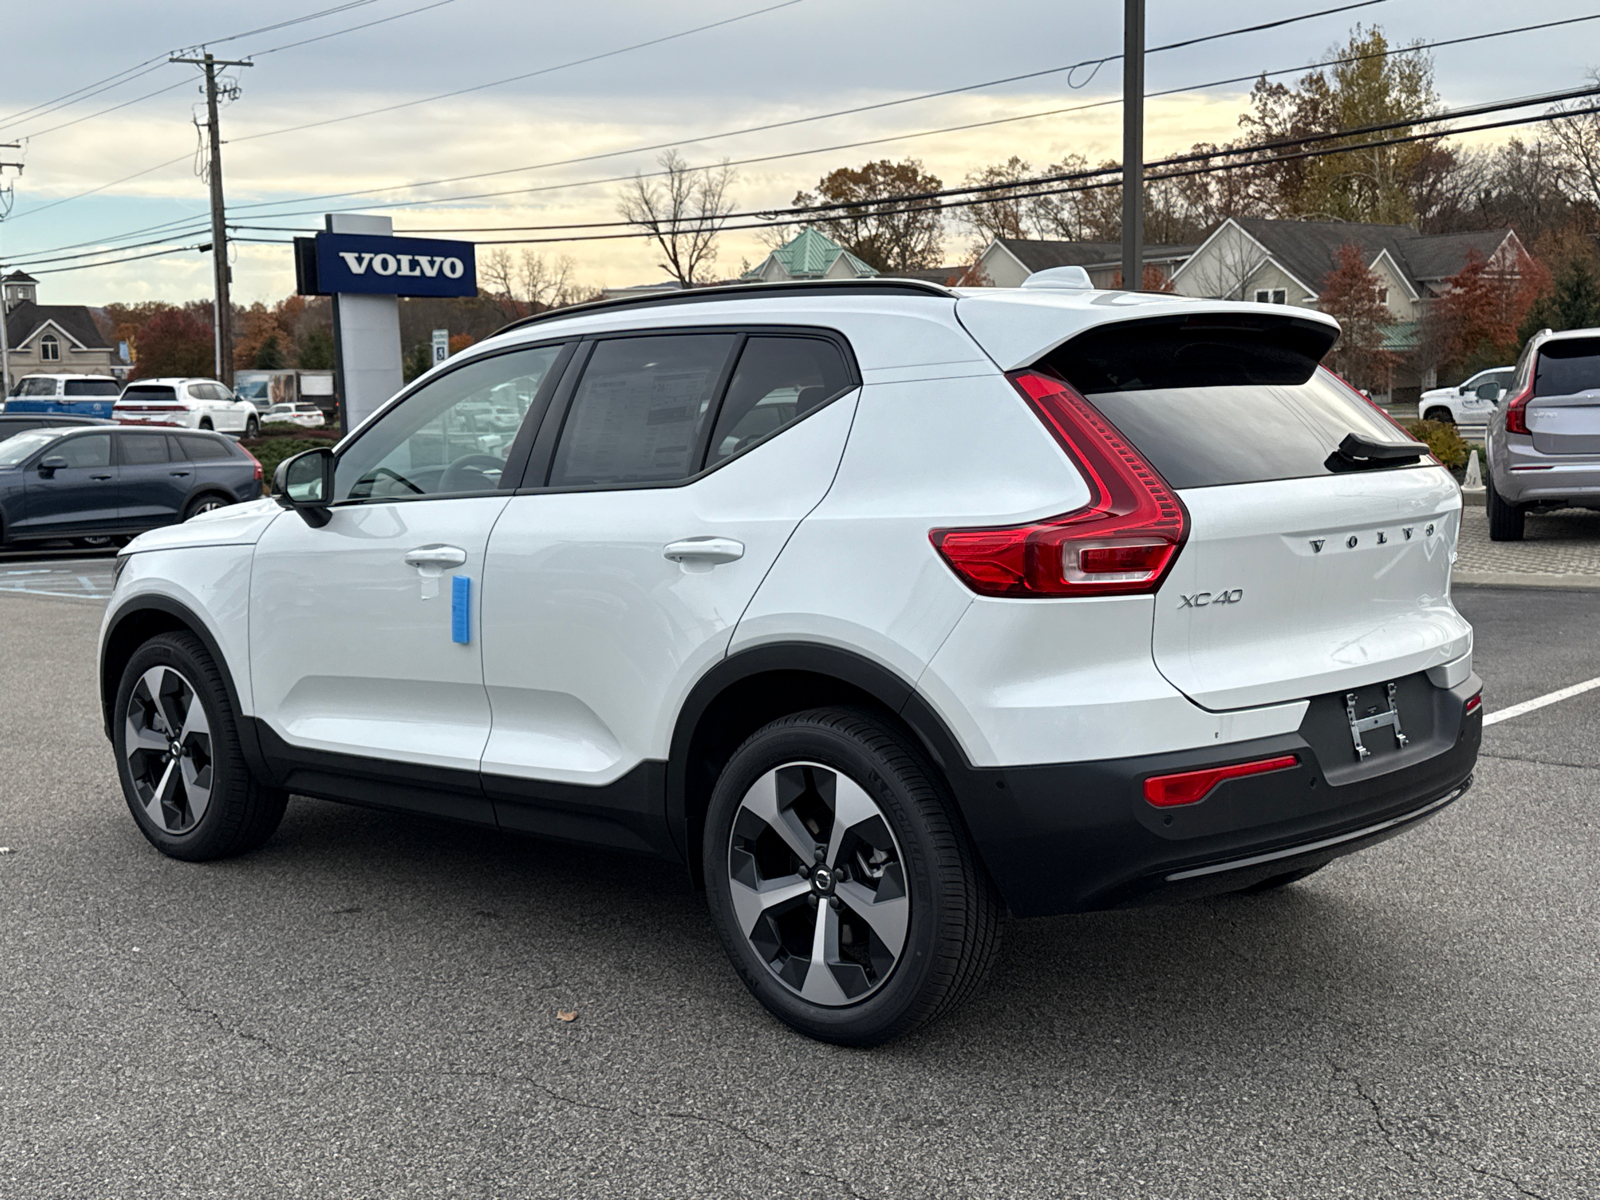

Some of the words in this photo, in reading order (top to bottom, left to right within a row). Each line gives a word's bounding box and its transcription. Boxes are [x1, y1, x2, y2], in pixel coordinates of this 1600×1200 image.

[339, 252, 464, 279] VOLVO
[1309, 523, 1435, 554] VOLVO
[1177, 589, 1243, 610] XC40
